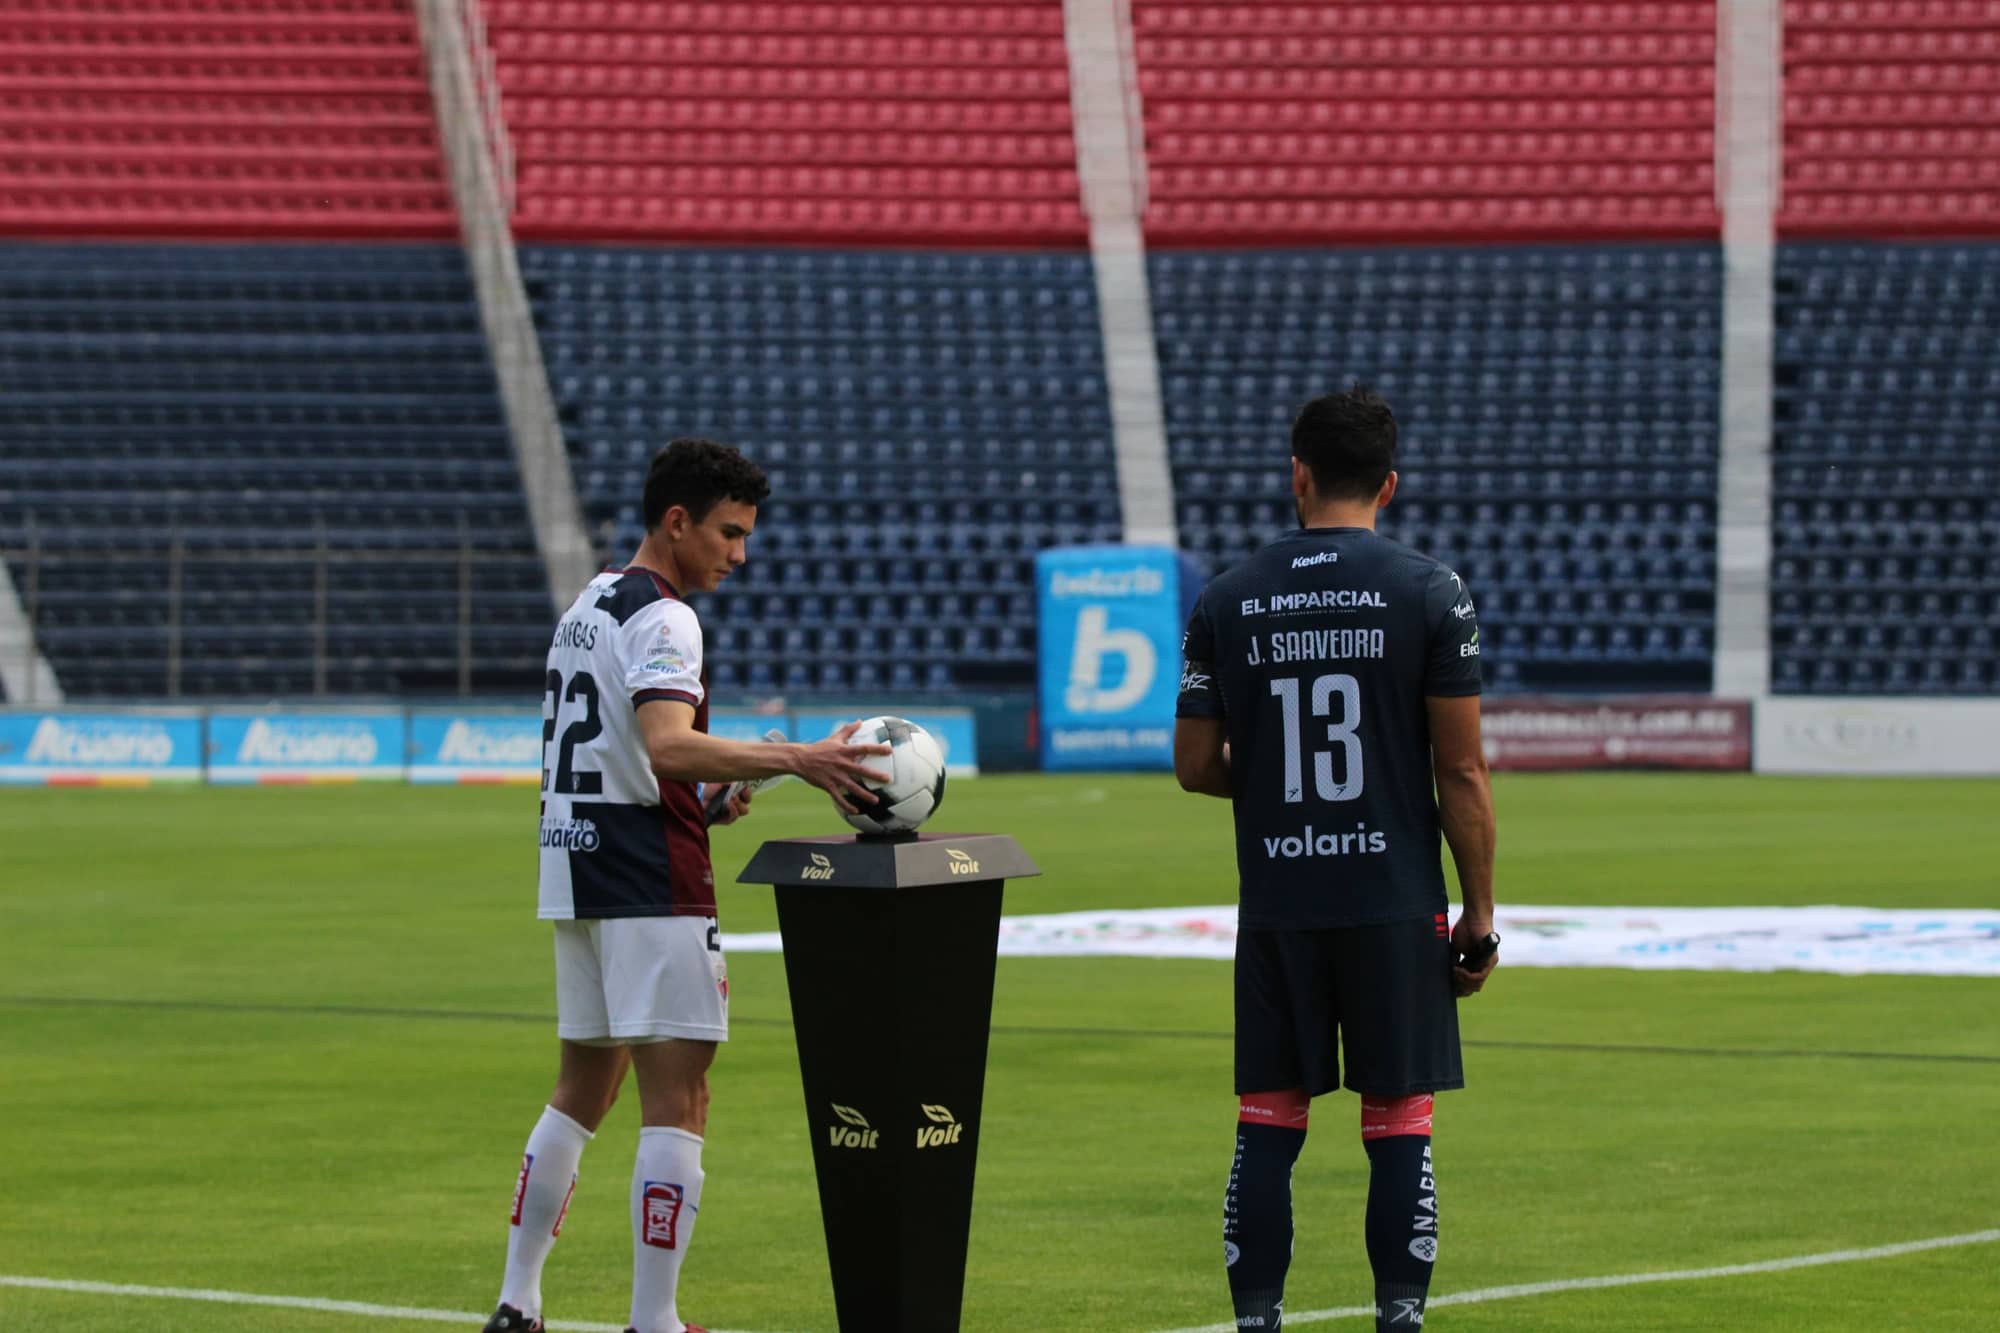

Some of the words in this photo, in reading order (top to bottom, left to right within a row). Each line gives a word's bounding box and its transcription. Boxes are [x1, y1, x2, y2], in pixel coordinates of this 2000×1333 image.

[1291, 552, 1338, 569] Keuka
[1241, 598, 1266, 616] EL
[1271, 590, 1387, 612] IMPARCIAL
[1066, 606, 1156, 713] b
[1247, 635, 1266, 666] J.
[1271, 628, 1384, 663] SAAVEDRA
[542, 669, 603, 794] 22
[1270, 673, 1364, 803] 13
[540, 828, 600, 851] uario
[1264, 823, 1386, 858] volaris
[801, 866, 835, 880] Voit
[949, 860, 980, 875] Voit
[829, 1126, 879, 1149] Voit
[916, 1123, 963, 1149] Voit
